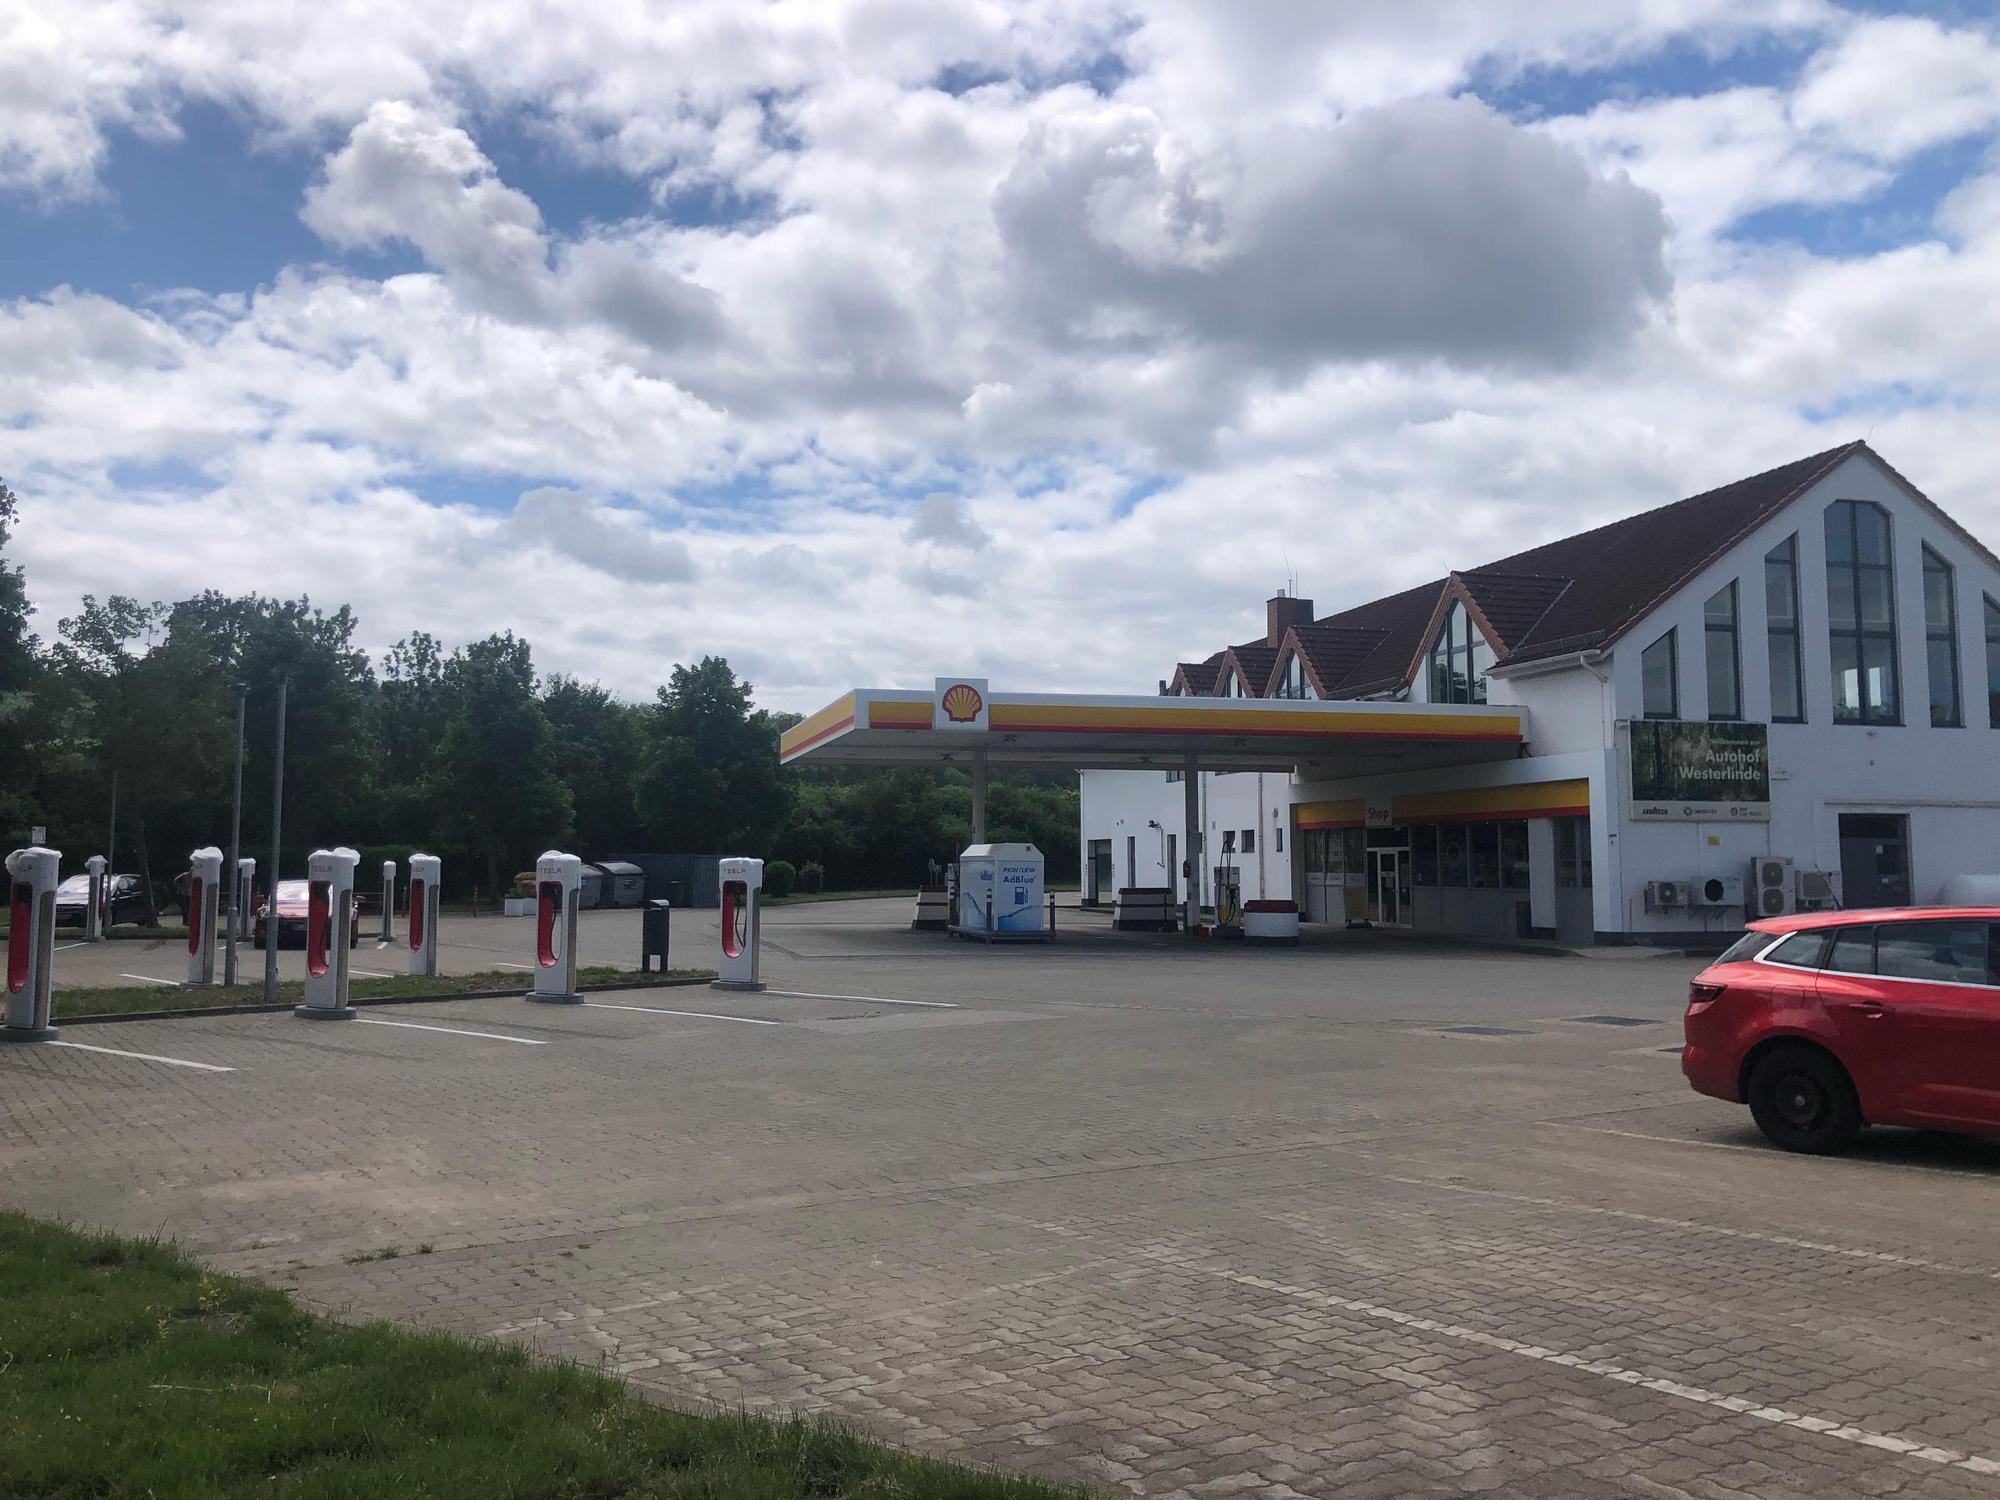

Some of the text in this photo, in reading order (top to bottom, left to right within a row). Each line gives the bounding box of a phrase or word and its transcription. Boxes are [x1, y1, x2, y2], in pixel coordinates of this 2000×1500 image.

[1705, 748, 1760, 763] Autohof
[1679, 765, 1761, 780] Westerlinde
[1368, 807, 1389, 823] Shop
